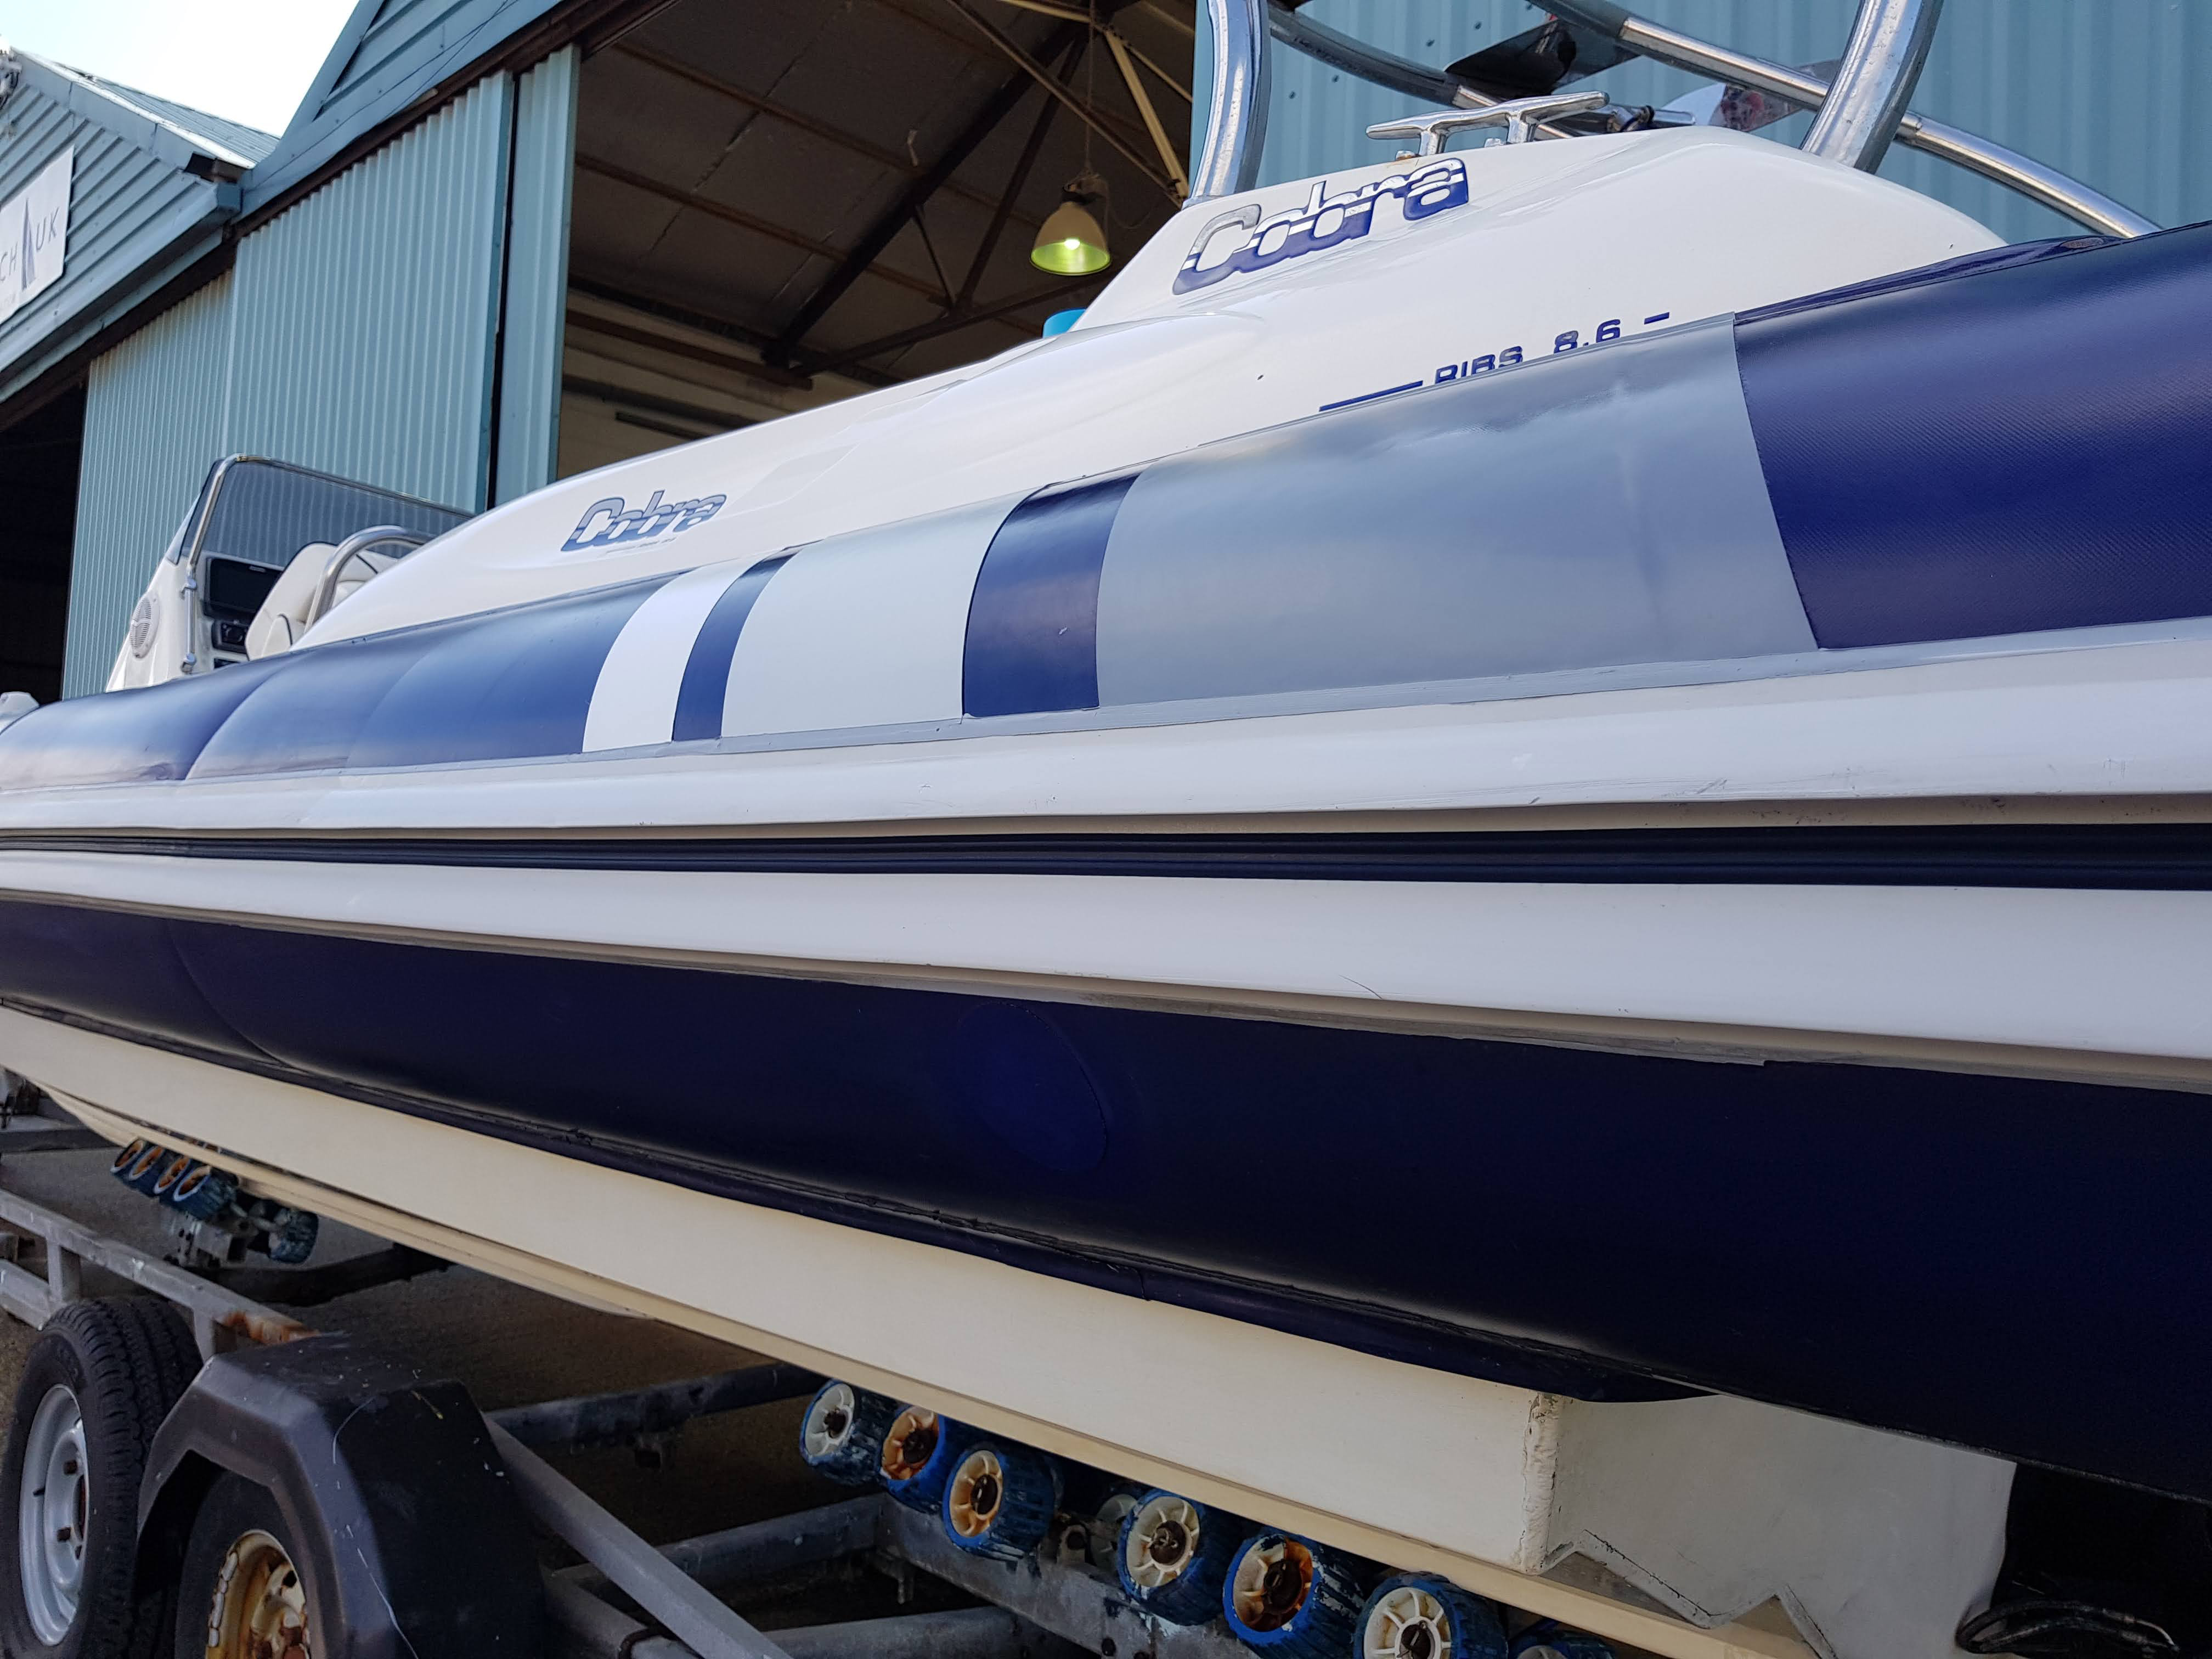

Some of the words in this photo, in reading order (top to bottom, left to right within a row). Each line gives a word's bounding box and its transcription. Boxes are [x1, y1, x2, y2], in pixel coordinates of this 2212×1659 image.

[36, 206, 60, 252] UK
[1172, 157, 1469, 295] Cobra
[1435, 345, 1523, 385] RIBS
[1553, 319, 1621, 353] 8.6
[561, 489, 727, 551] Cobra
